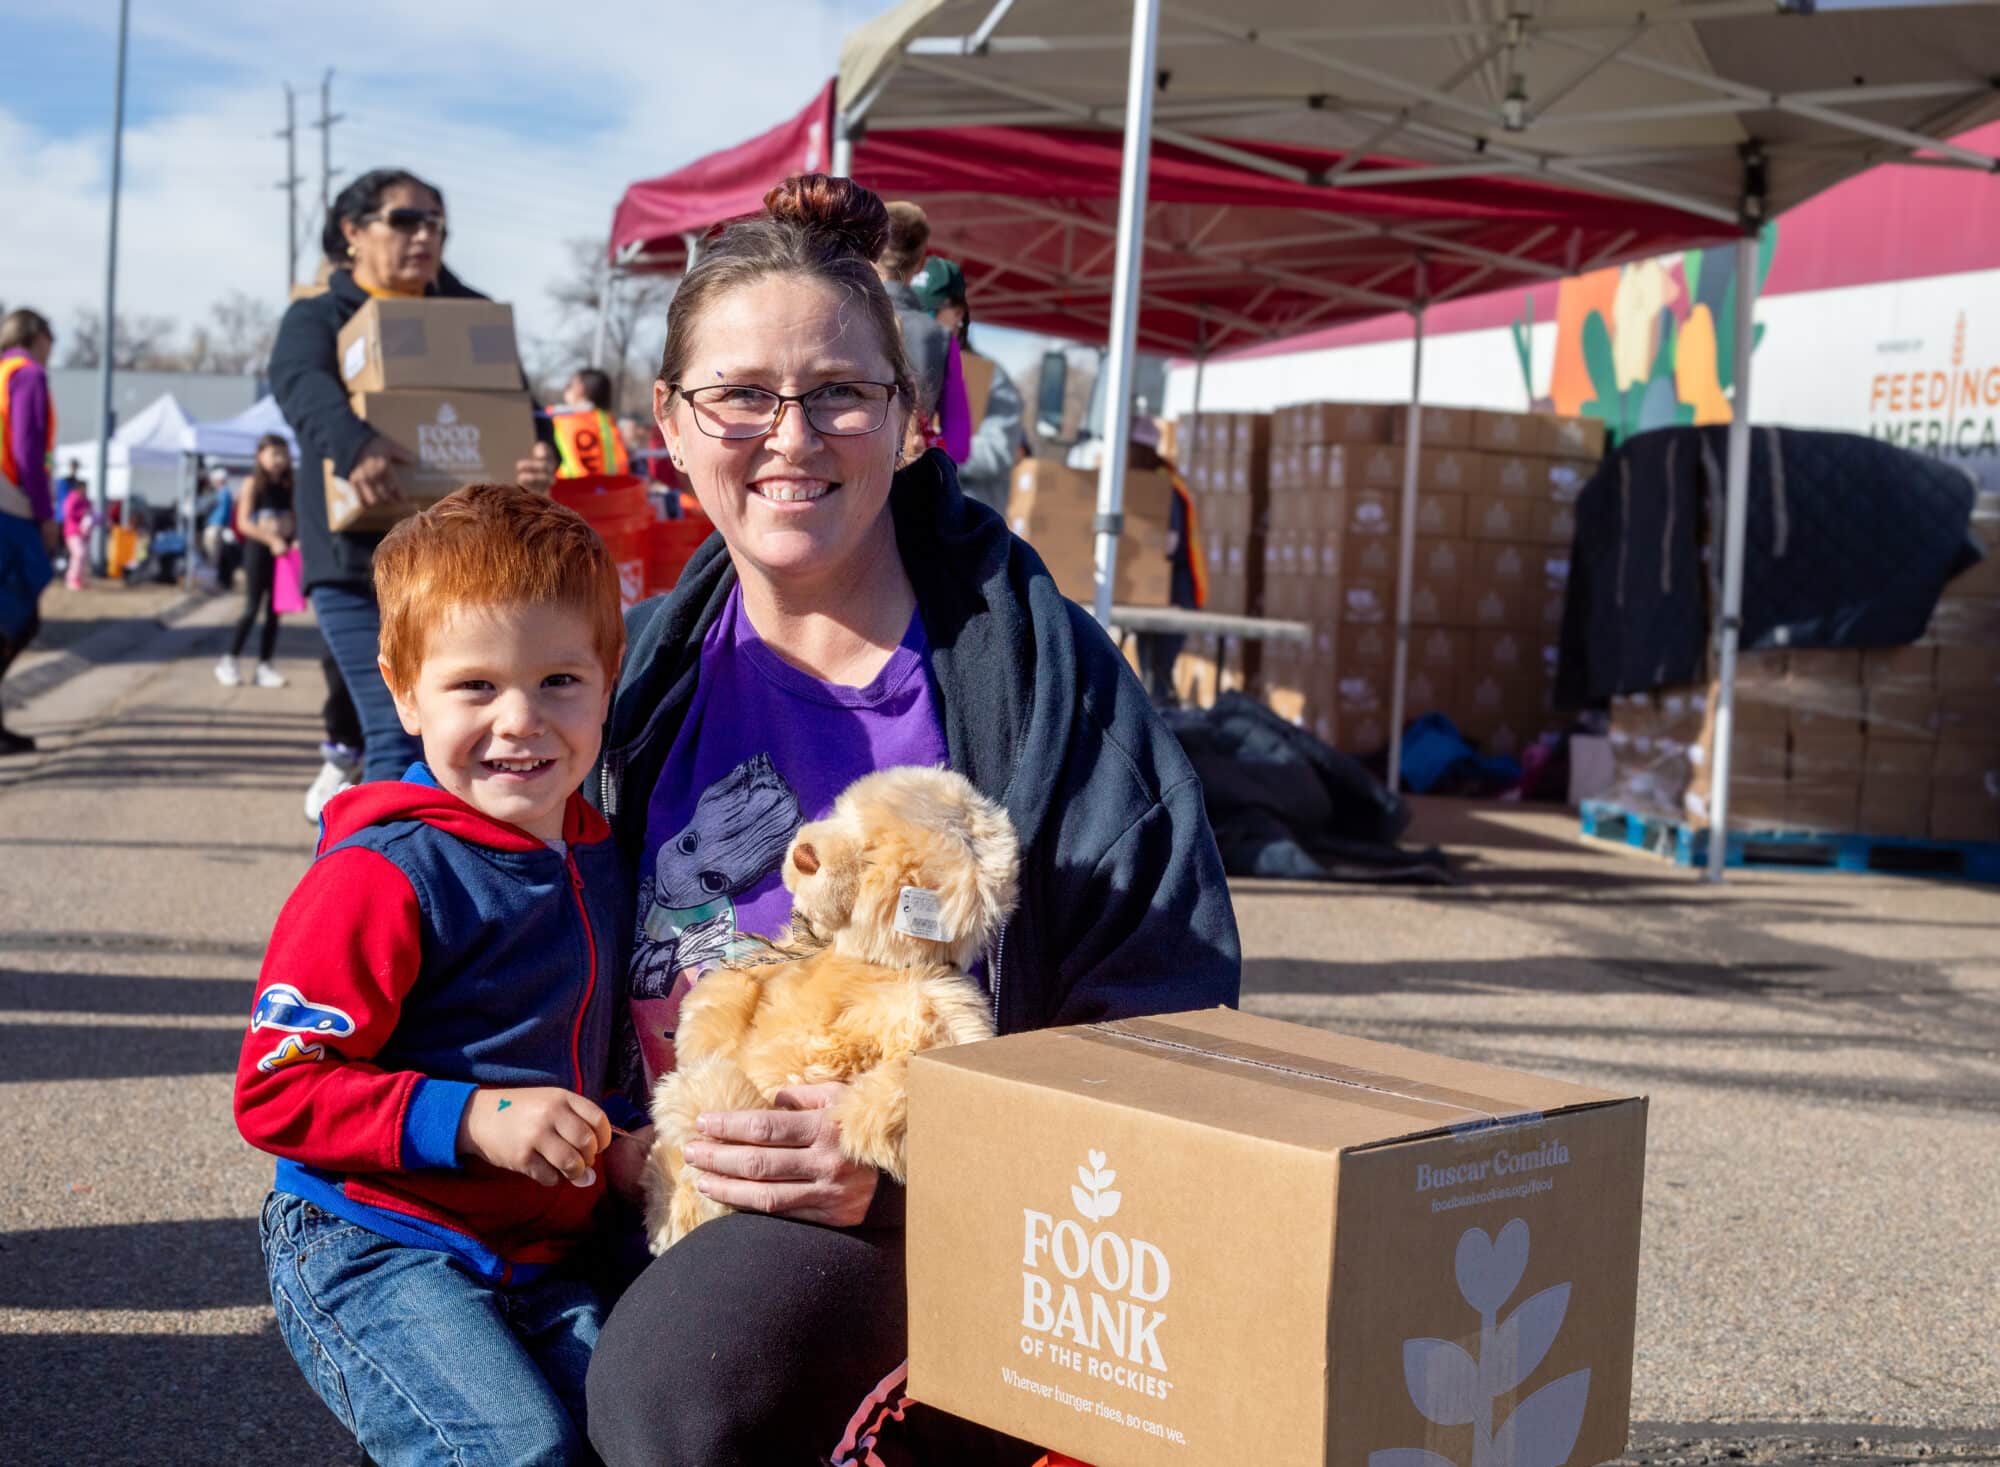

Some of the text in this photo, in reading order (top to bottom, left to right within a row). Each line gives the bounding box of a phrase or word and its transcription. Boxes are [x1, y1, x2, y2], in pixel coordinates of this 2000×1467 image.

[1869, 366, 2000, 416] FEEDING
[419, 424, 479, 442] FOOD
[419, 443, 482, 464] BANK
[1416, 1139, 1569, 1191] Buscar Comida
[1023, 1208, 1170, 1302] FOOD
[1022, 1271, 1168, 1372] BANK
[1020, 1335, 1044, 1359] OF
[1049, 1343, 1082, 1373] THE
[1002, 1367, 1187, 1446] Wherever hunger rises, so can we.
